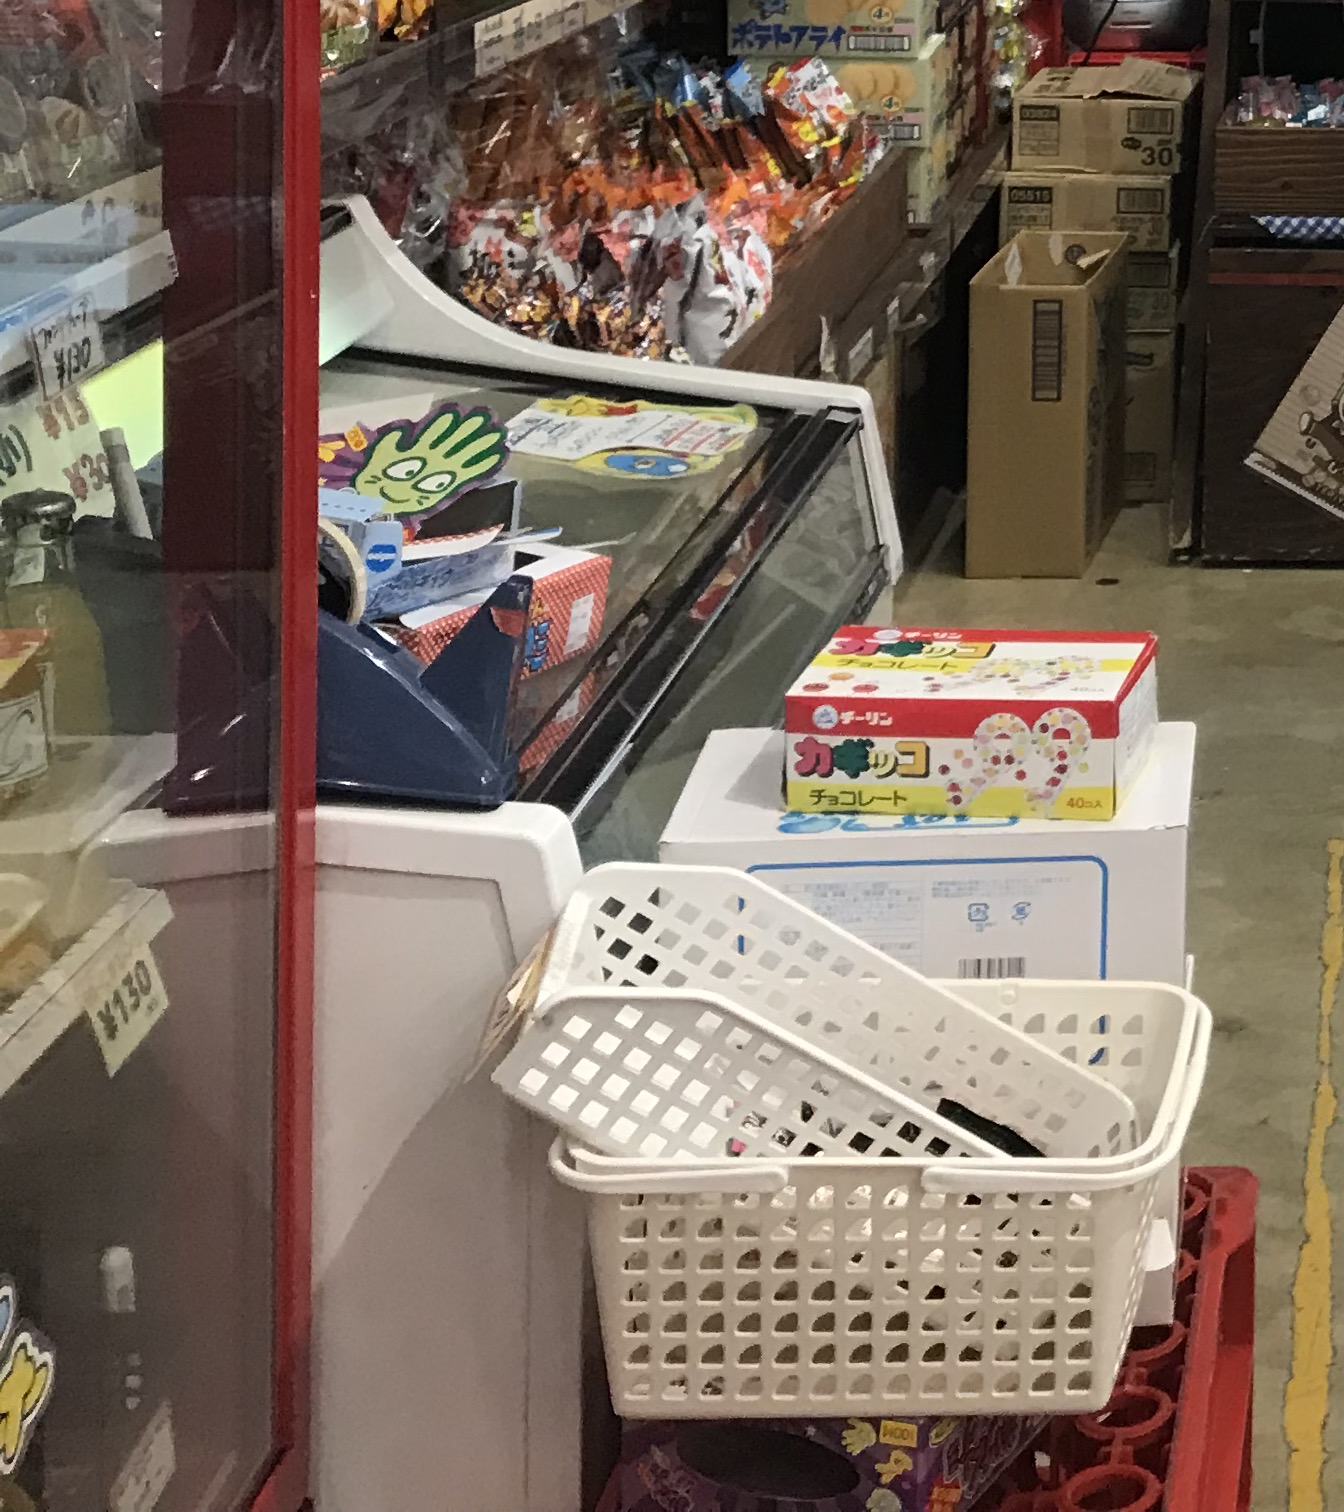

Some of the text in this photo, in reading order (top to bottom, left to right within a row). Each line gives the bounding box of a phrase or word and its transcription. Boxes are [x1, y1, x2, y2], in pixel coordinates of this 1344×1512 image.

[1140, 145, 1174, 167] 30
[835, 656, 960, 672] チョコレート
[838, 710, 894, 727] チーリン
[793, 736, 932, 779] カギッコ
[808, 788, 908, 809] チョコレート
